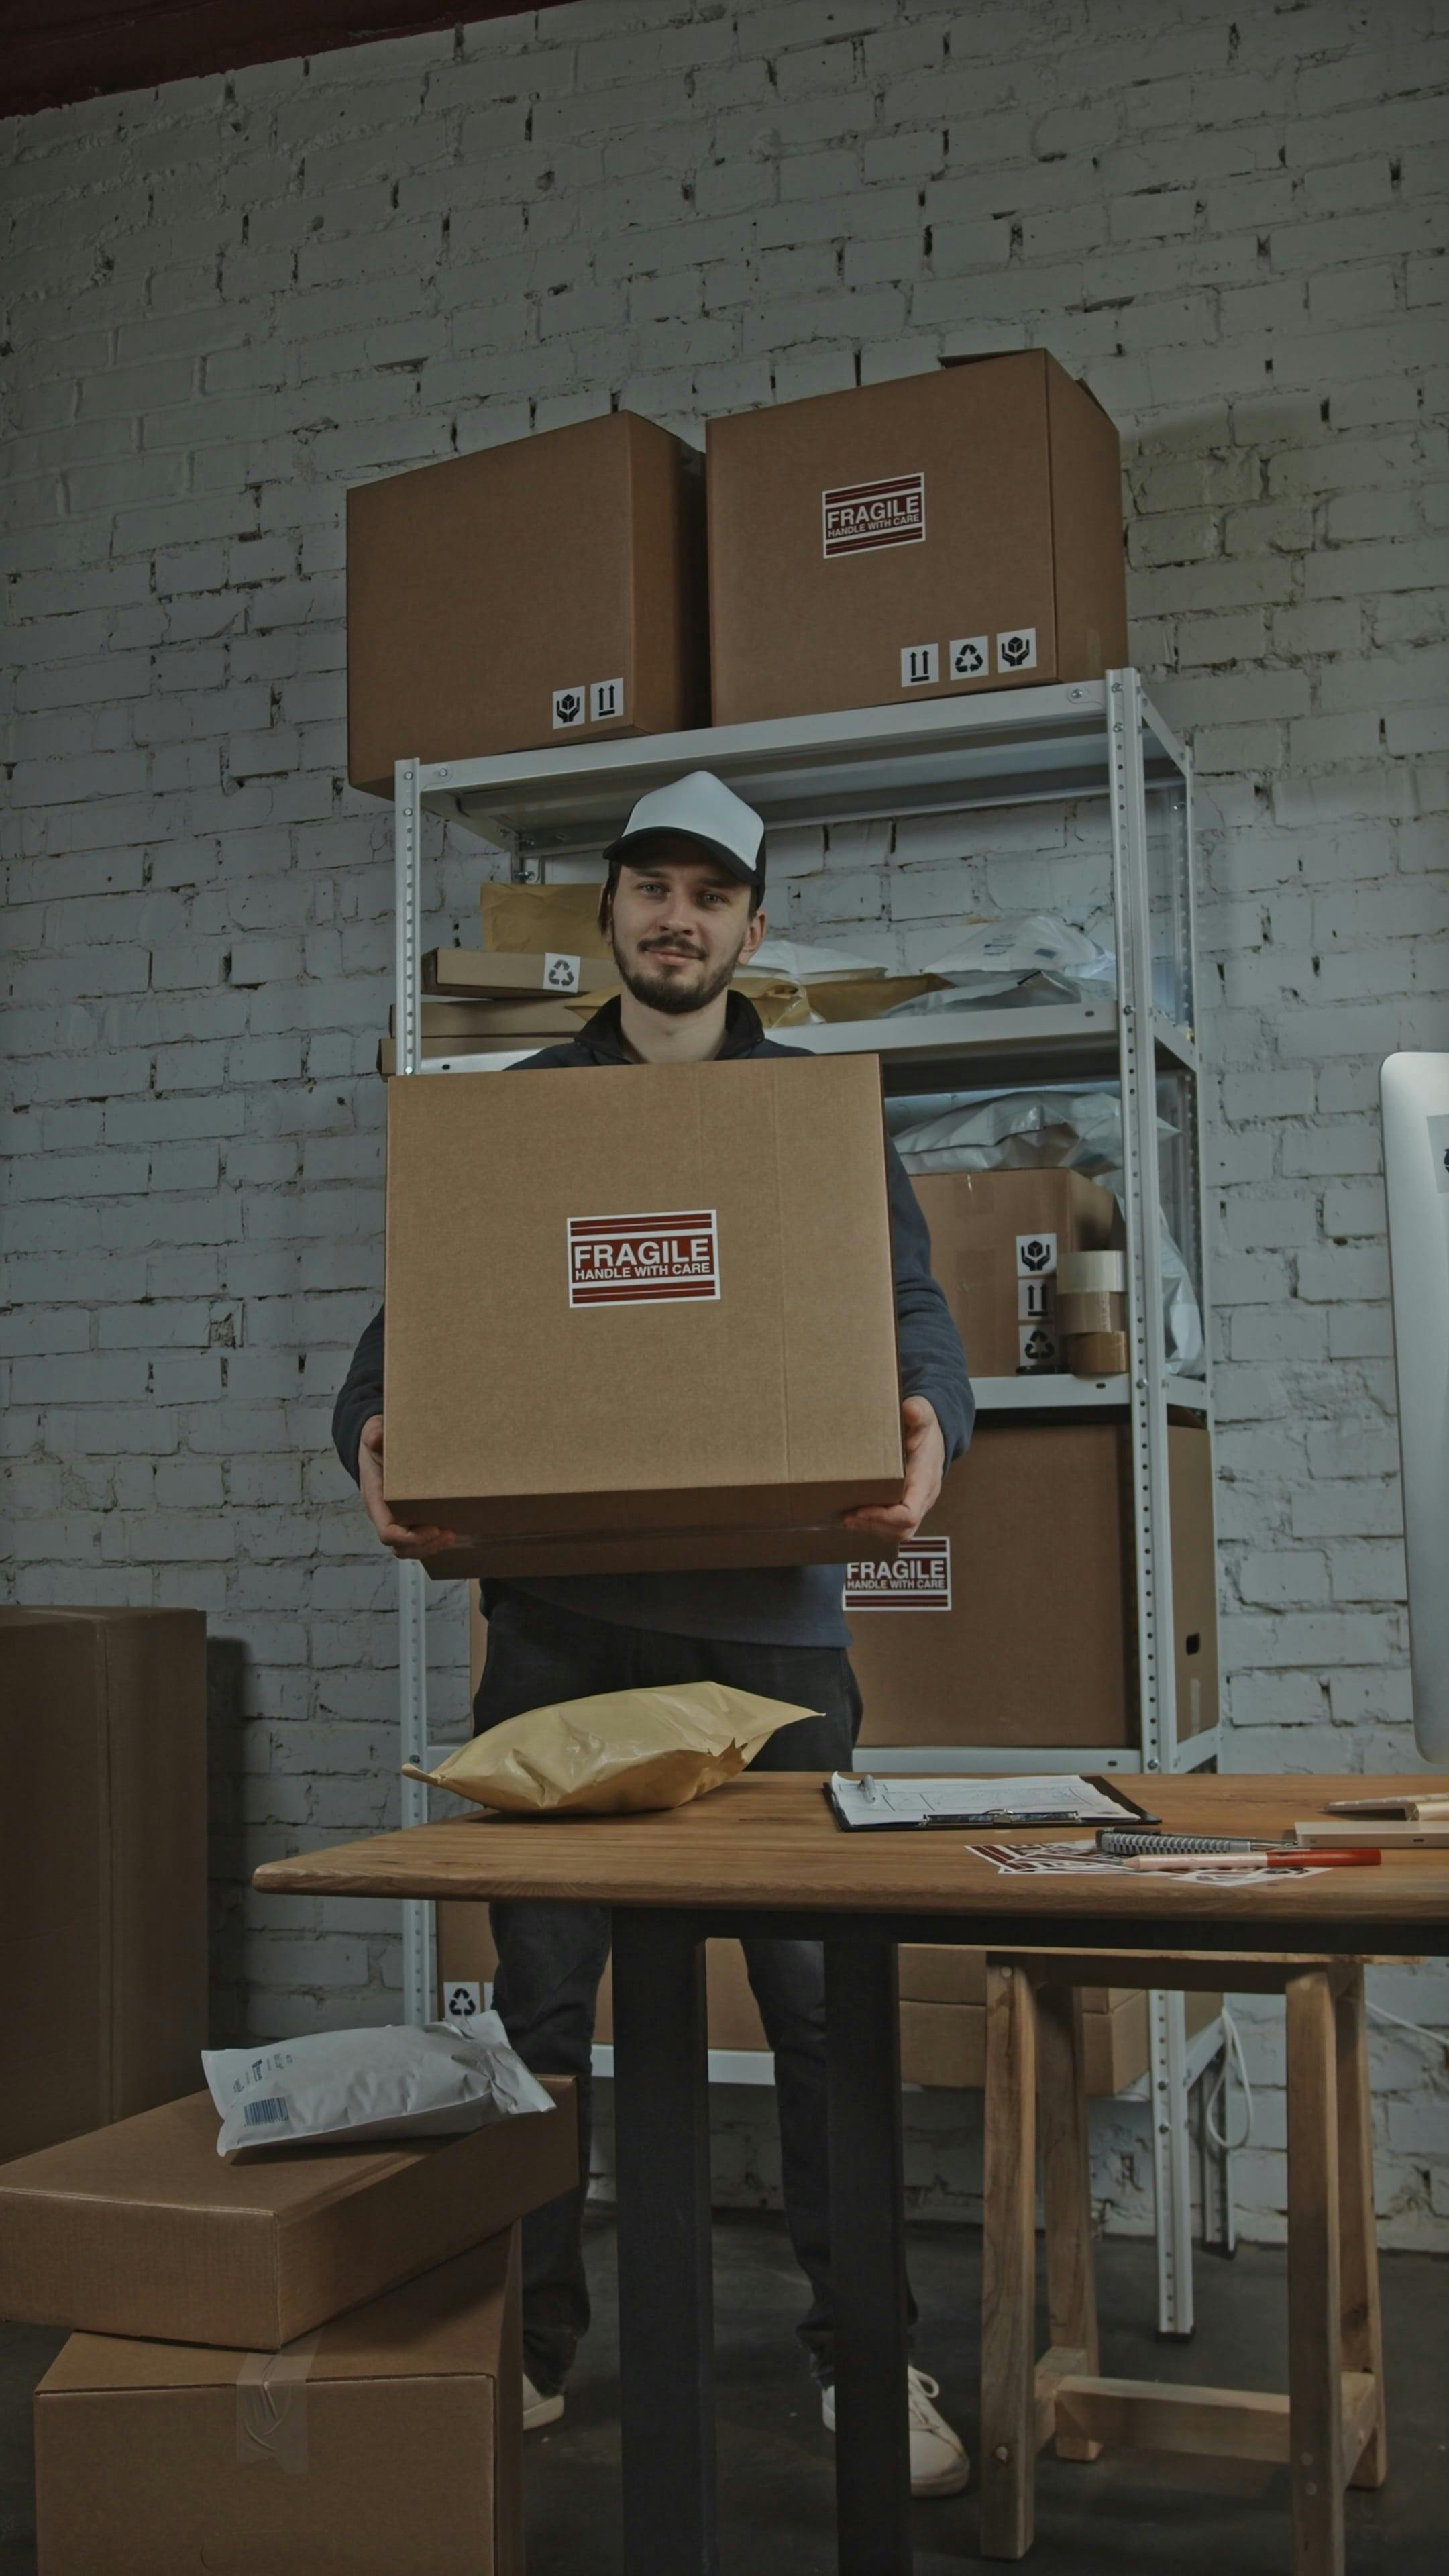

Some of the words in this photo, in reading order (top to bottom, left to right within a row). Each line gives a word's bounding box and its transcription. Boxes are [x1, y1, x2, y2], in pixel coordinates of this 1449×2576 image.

[827, 495, 920, 529] FRAGILE
[828, 523, 866, 537] HANDLE
[867, 519, 891, 530] WITH
[893, 514, 920, 526] CARE
[574, 1238, 710, 1269] FRAGILE
[575, 1267, 631, 1281] HANDLE
[634, 1265, 668, 1277] WITH
[672, 1262, 710, 1275] CARE
[847, 1560, 945, 1580] FRAGILE
[847, 1579, 888, 1589] HANDLE
[890, 1579, 914, 1589] WITH
[916, 1579, 945, 1589] CARE
